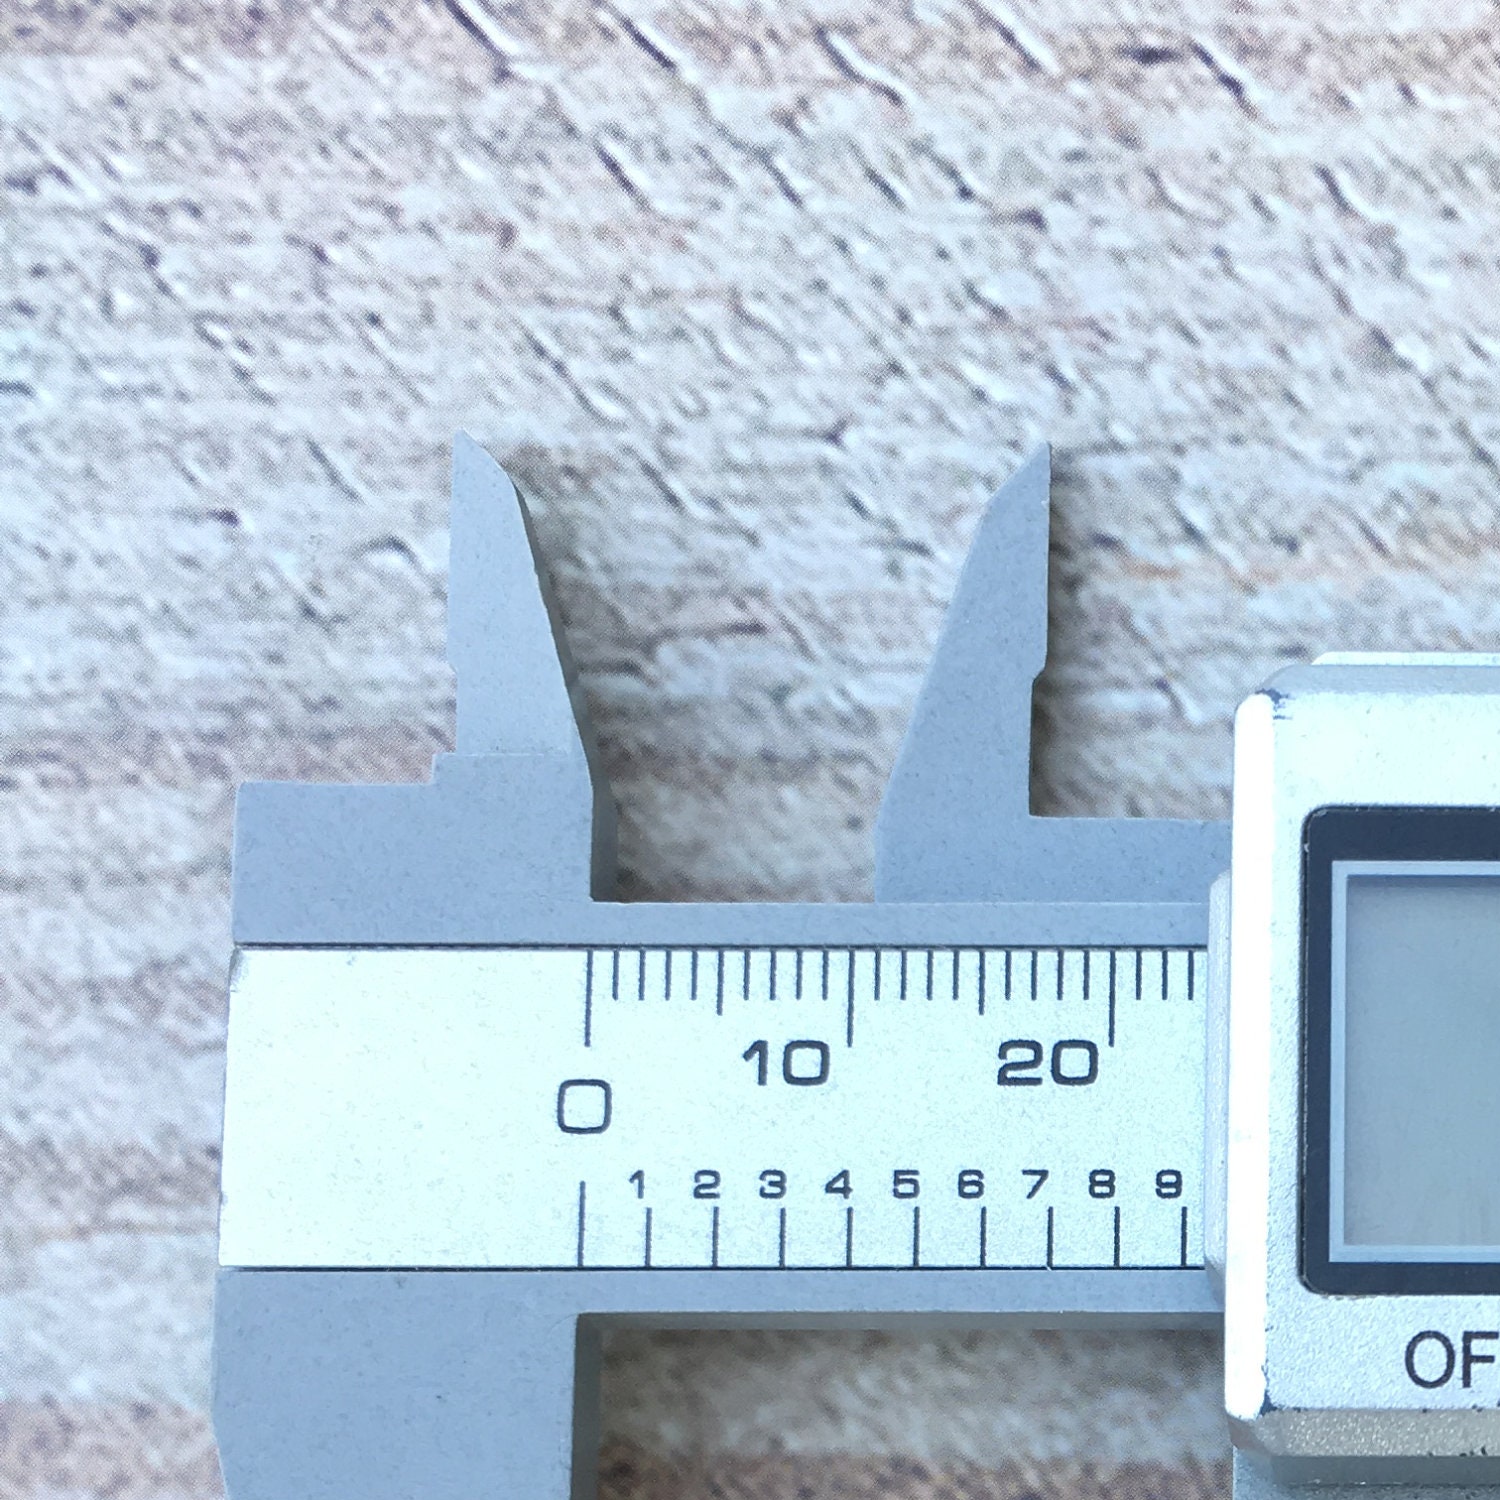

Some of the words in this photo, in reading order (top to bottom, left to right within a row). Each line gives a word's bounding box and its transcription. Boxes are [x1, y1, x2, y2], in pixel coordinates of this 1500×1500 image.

[742, 1039, 830, 1086] 10
[996, 1039, 1099, 1087] 20
[556, 1078, 612, 1135] 0
[628, 1169, 646, 1200] 1
[693, 1169, 722, 1200] 2
[758, 1169, 788, 1200] 3
[824, 1169, 853, 1200] 4
[892, 1169, 921, 1200] 5
[957, 1169, 985, 1200] 6
[1020, 1169, 1050, 1200] 7
[1087, 1169, 1117, 1200] 8
[1154, 1169, 1184, 1200] 9
